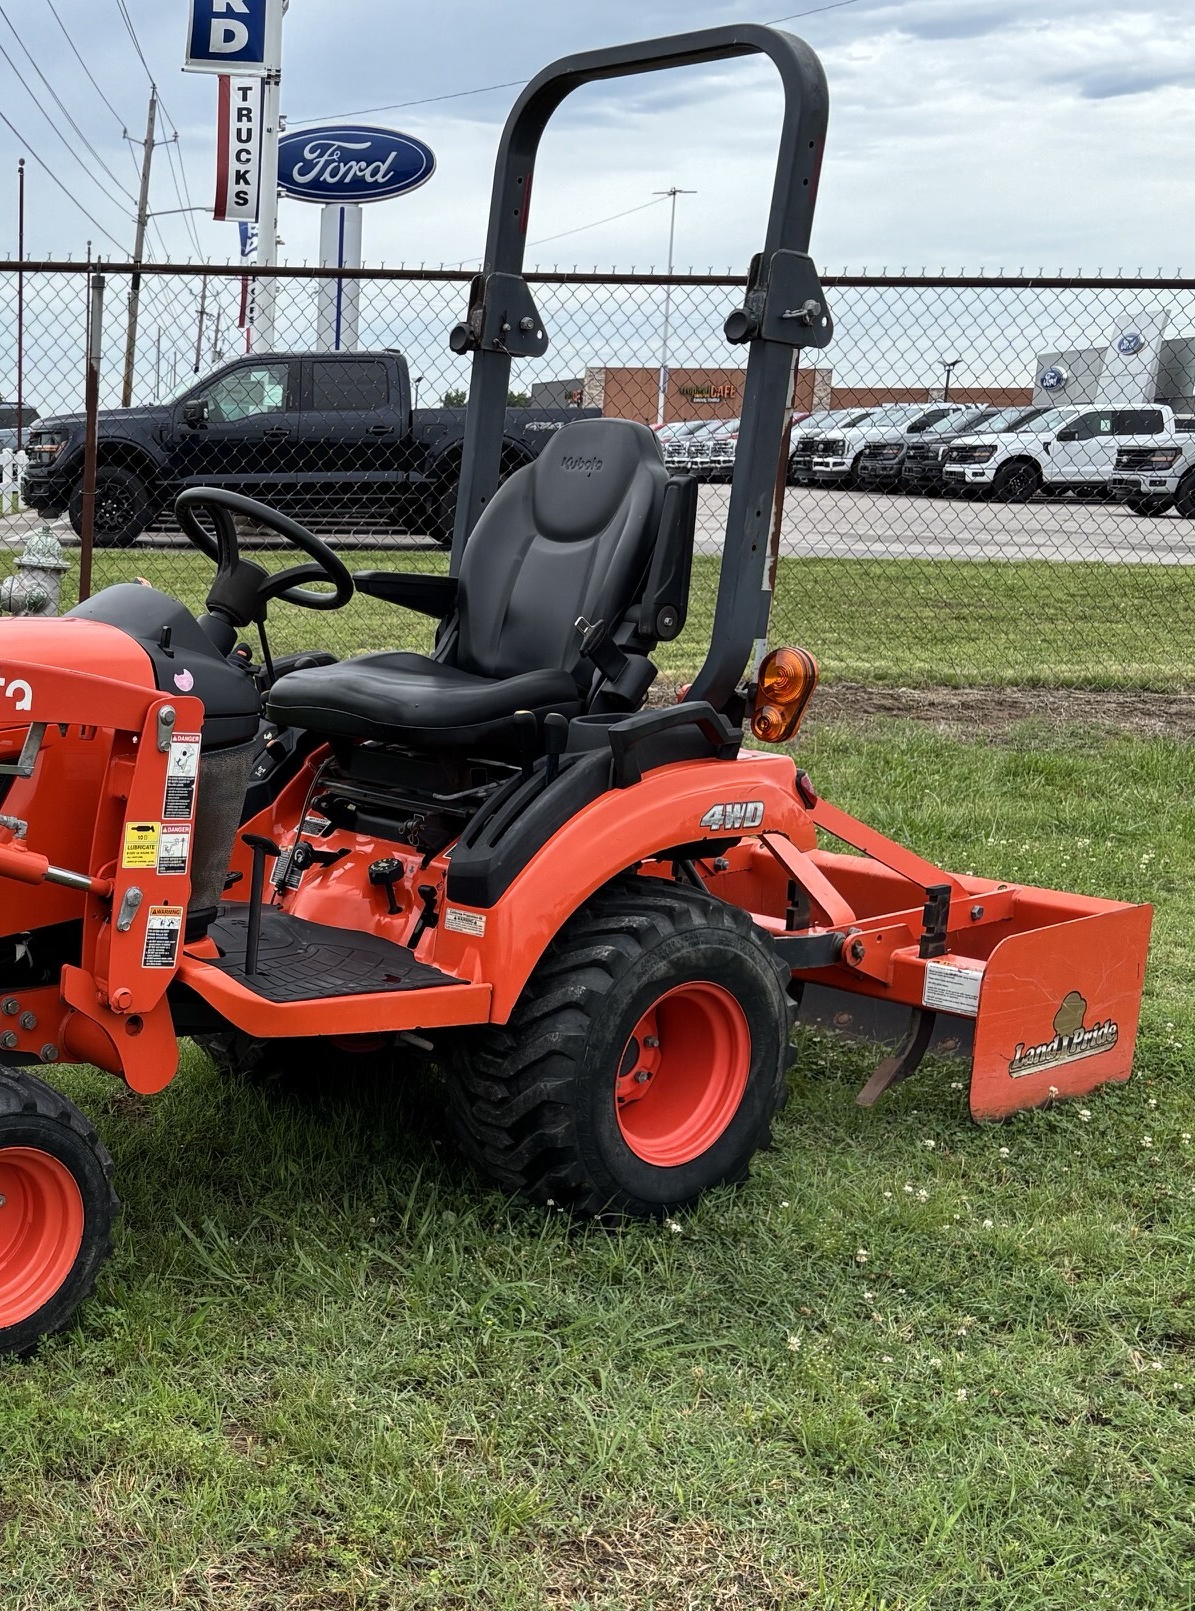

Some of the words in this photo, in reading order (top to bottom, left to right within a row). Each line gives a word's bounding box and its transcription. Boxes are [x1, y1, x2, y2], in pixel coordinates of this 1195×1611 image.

[234, 86, 253, 207] TRUCKS
[292, 140, 398, 184] Ford
[561, 456, 603, 471] Kubota
[700, 800, 765, 831] 4WD
[1010, 1036, 1062, 1069] Land
[1069, 1019, 1118, 1054] Pride
